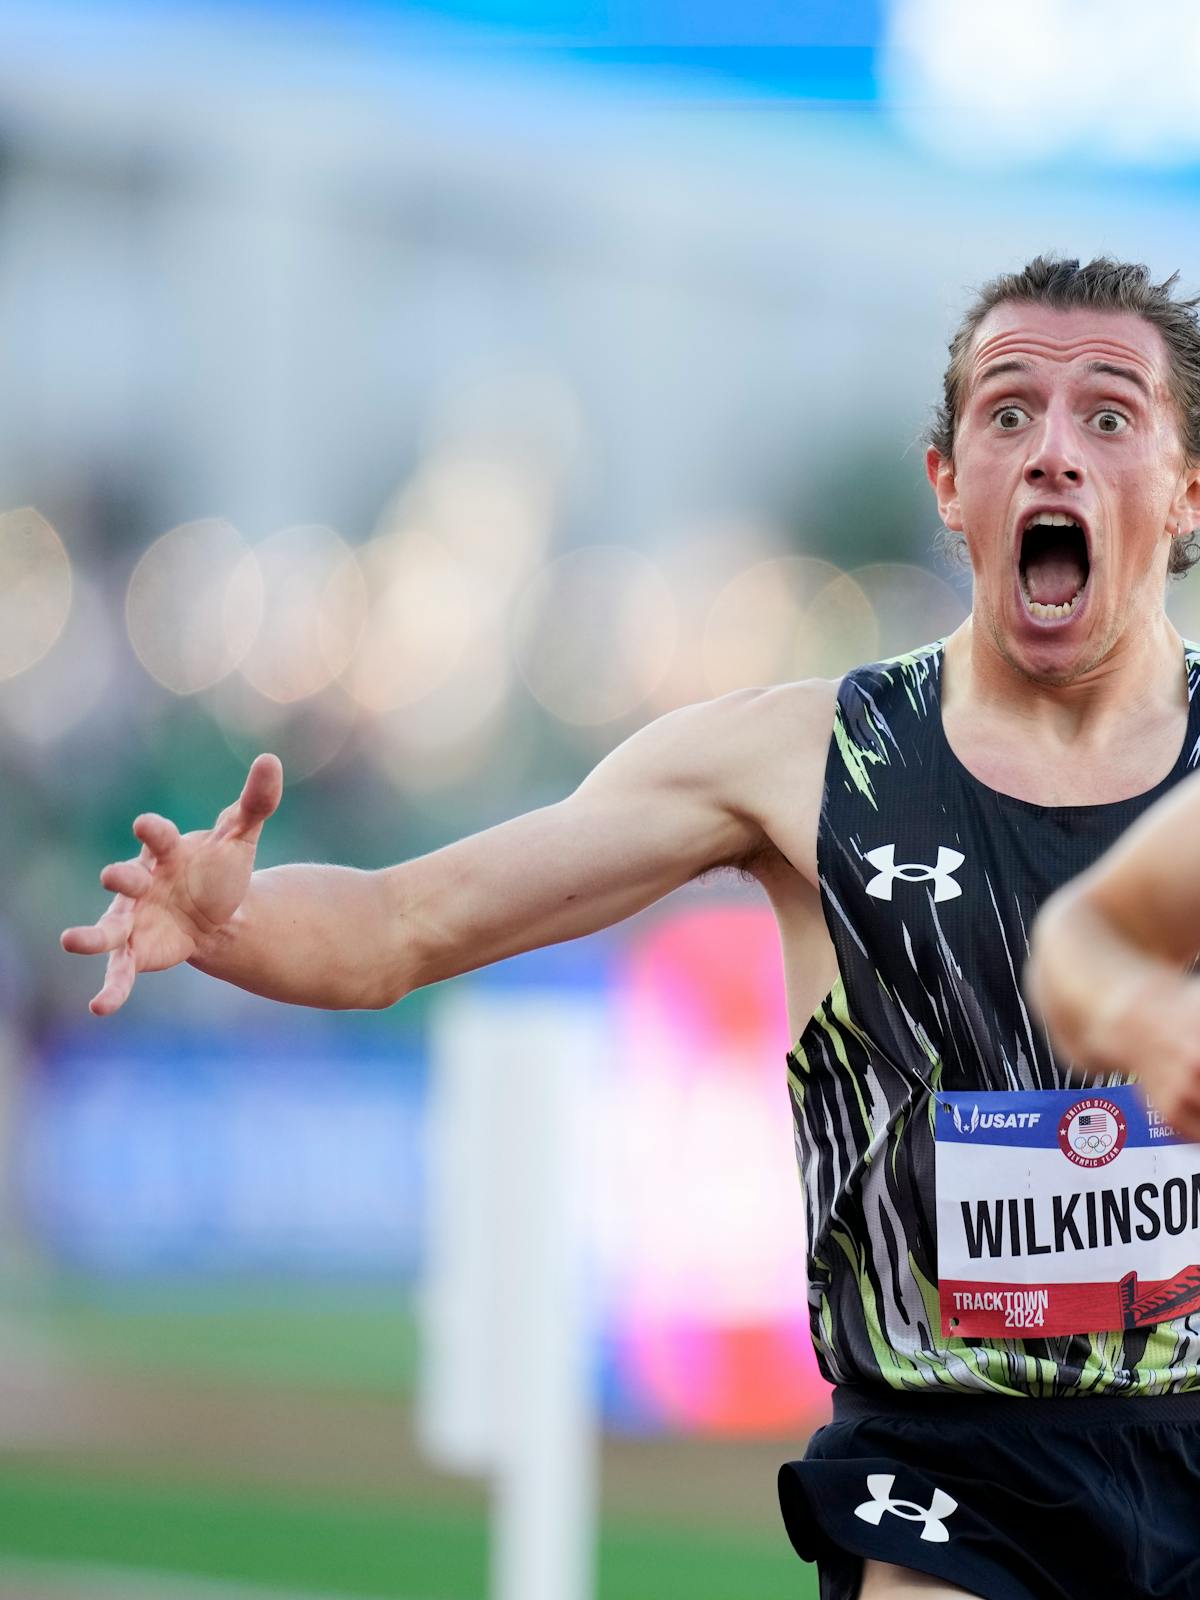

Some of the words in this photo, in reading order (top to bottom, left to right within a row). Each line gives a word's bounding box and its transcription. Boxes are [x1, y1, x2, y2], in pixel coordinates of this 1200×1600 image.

[1065, 1100, 1091, 1120] UNITED
[1094, 1100, 1120, 1116] STATES
[980, 1113, 1041, 1128] USATF
[1066, 1151, 1098, 1167] OLYMPIC
[1102, 1147, 1119, 1164] TEAM
[953, 1290, 1049, 1311] TRACKTOWN
[1005, 1307, 1045, 1328] 2024
